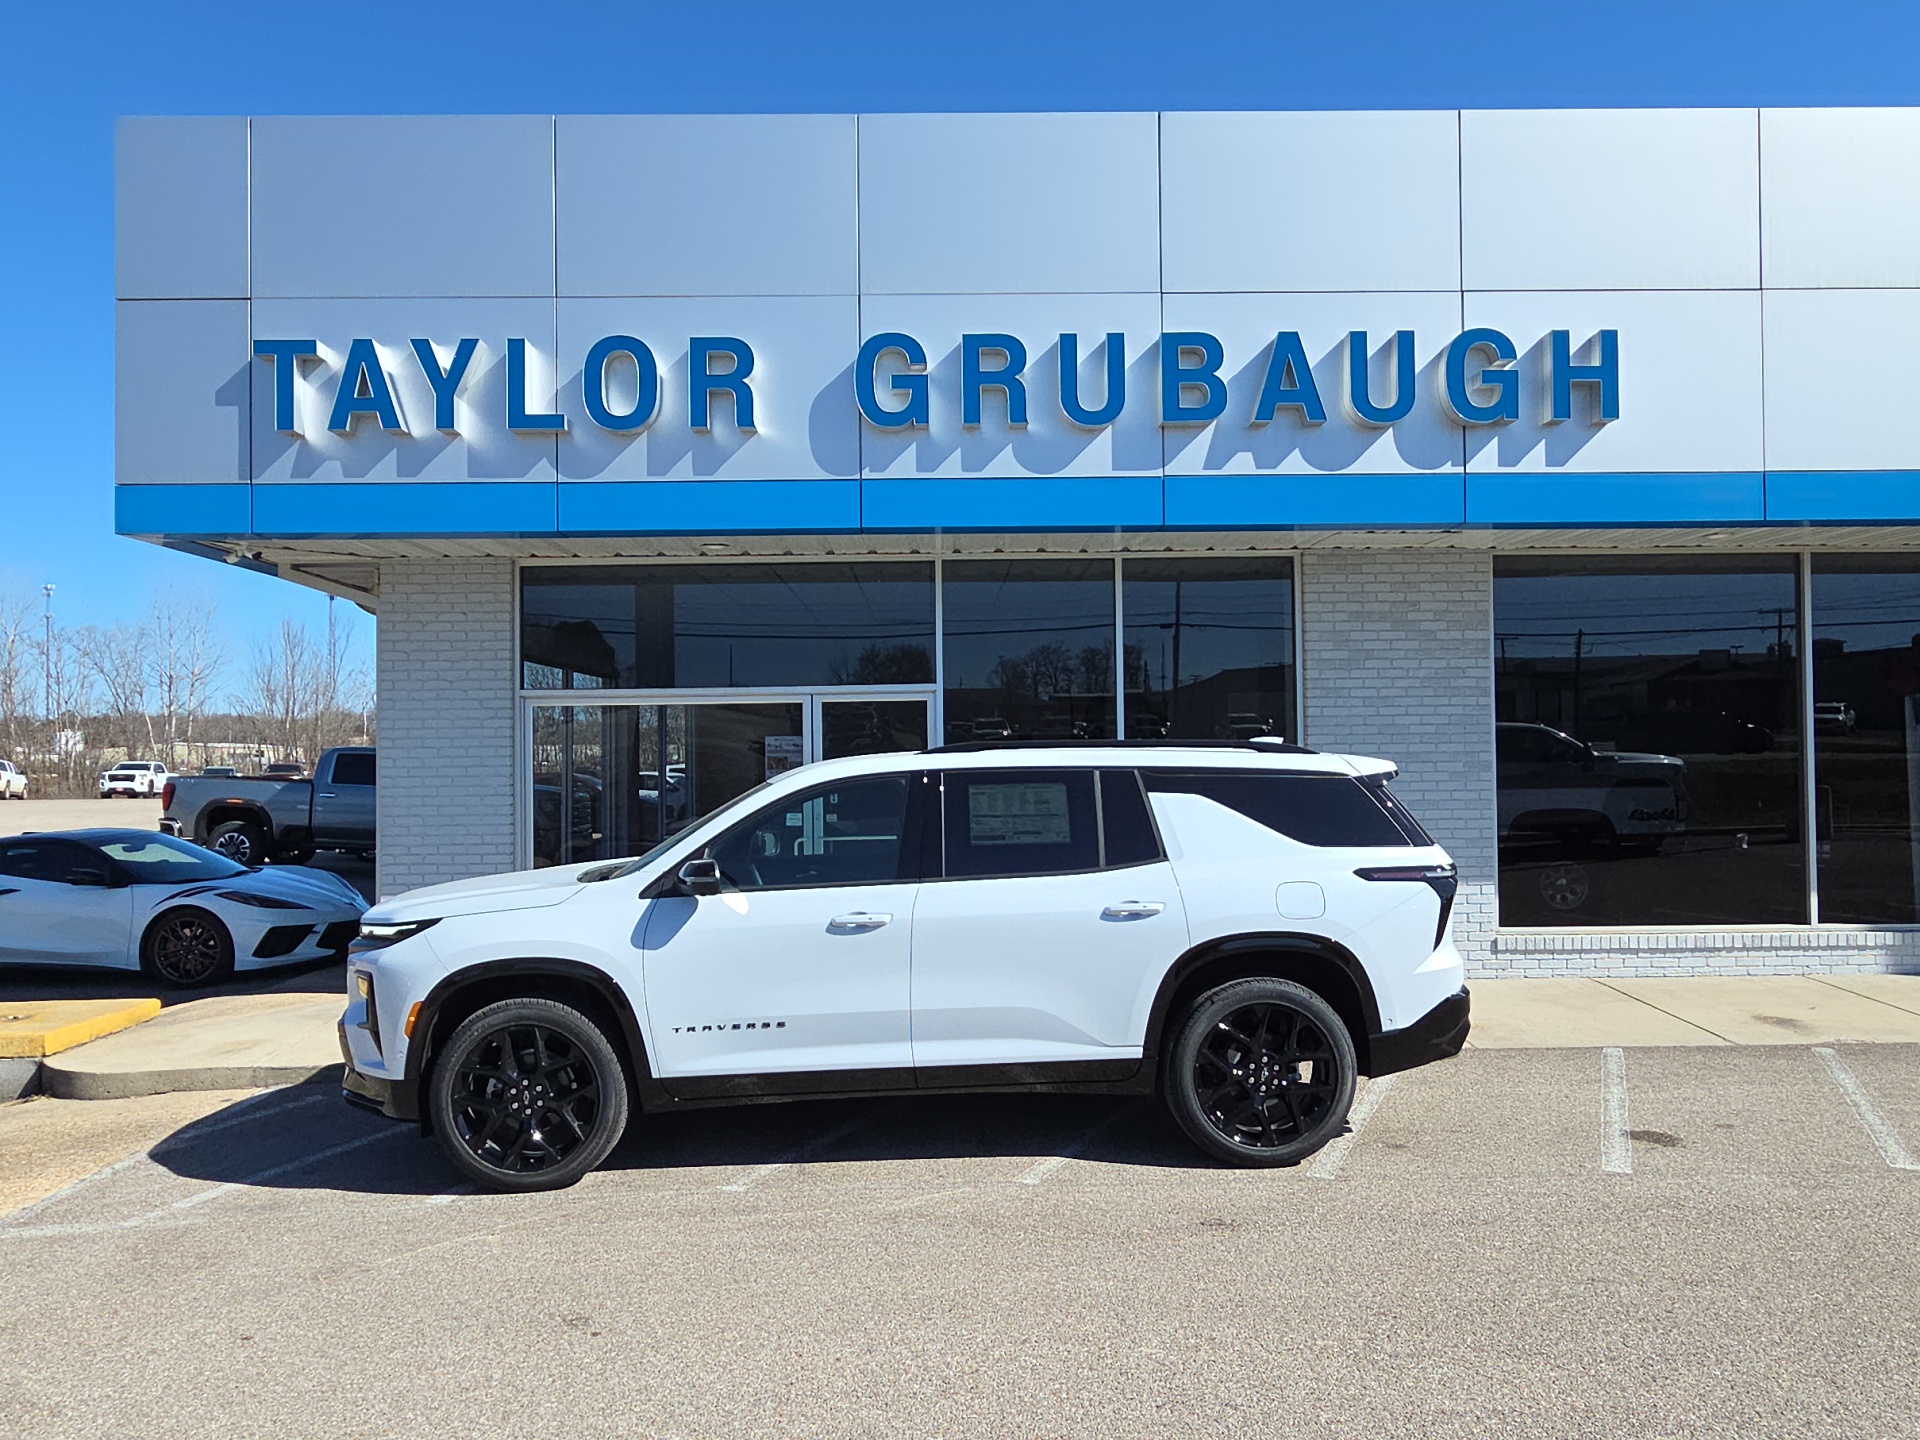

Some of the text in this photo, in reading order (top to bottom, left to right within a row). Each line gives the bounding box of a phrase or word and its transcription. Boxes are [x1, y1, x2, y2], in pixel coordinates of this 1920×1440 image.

[253, 327, 1619, 435] TAYLOR GRUBAUGH
[671, 1021, 786, 1034] TRAVERSE
